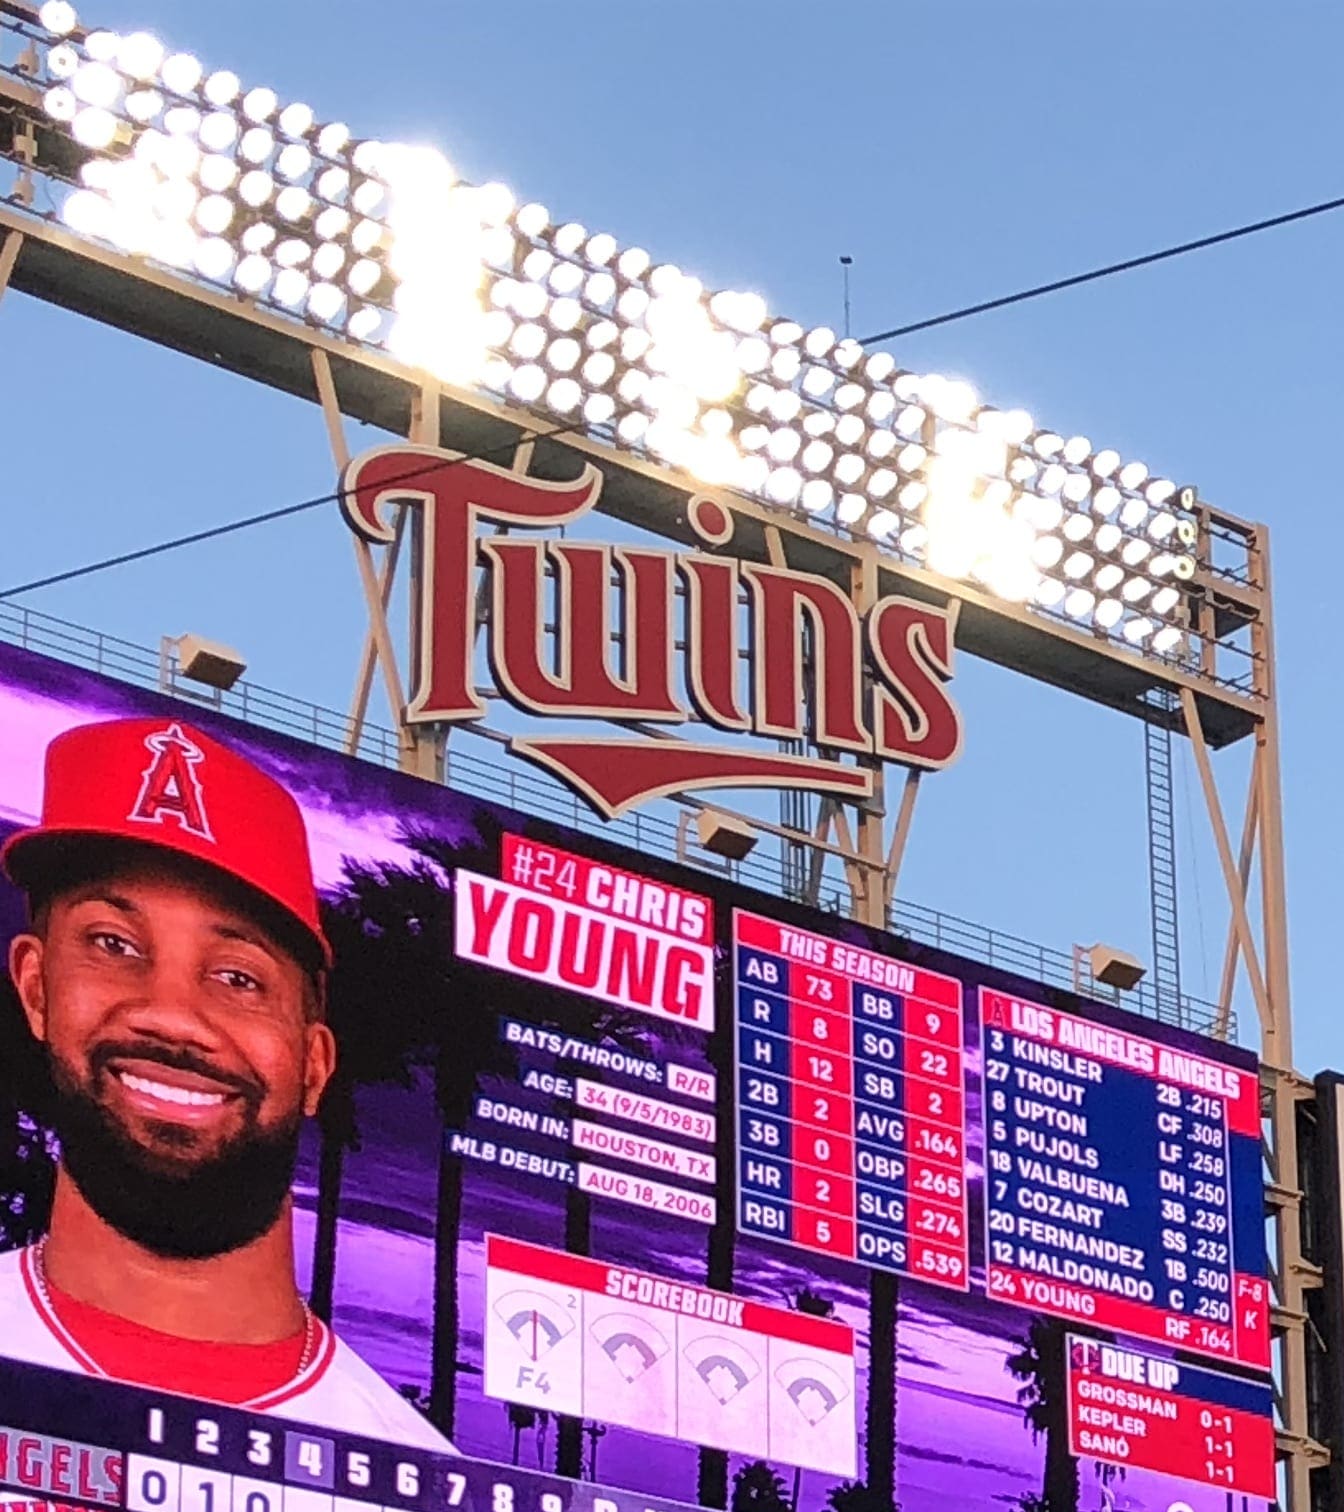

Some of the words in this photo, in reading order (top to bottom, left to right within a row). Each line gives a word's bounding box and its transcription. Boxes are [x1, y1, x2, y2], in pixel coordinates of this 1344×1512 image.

[341, 445, 964, 770] Twins
[512, 844, 577, 898] #24
[585, 866, 707, 939] CHRIS
[469, 881, 705, 1021] YOUNG
[745, 958, 778, 984] AB
[806, 975, 833, 1001] 73
[780, 929, 826, 964] THIS
[832, 946, 915, 993] SEASON
[862, 993, 893, 1020] BB
[506, 1022, 663, 1083] BATS/THROWS:
[675, 1071, 710, 1095] R/R
[863, 1033, 895, 1059] SO
[921, 1051, 948, 1076] 22
[1011, 1002, 1053, 1040] LOS
[1058, 1017, 1154, 1073] ANGELES
[1159, 1050, 1240, 1099] ANGELS
[1013, 1037, 1103, 1083] KINSLER
[1156, 1084, 1182, 1107] 2B
[524, 1070, 574, 1099] AGE:
[584, 1087, 606, 1108] 34
[613, 1092, 713, 1138] (9/5/1983)
[864, 1073, 895, 1099] SB
[1014, 1067, 1086, 1106] TROUT
[1157, 1113, 1182, 1135] CF
[477, 1099, 538, 1131] BORN
[542, 1115, 569, 1140] IN:
[580, 1128, 680, 1173] HOUSTON,
[687, 1157, 710, 1176] TX
[858, 1111, 905, 1141] AVG
[915, 1130, 958, 1158] .164
[1015, 1096, 1087, 1137] UPTON
[1159, 1142, 1182, 1165] LF
[1016, 1127, 1099, 1170] PUJOLS
[1159, 1169, 1185, 1196] DH
[452, 1135, 497, 1162] MLB
[500, 1148, 575, 1184] DEBUT:
[587, 1172, 628, 1195] AUG
[634, 1184, 658, 1207] 18,
[665, 1193, 712, 1218] 2006
[748, 1161, 781, 1189] HR
[858, 1152, 905, 1180] OBP
[913, 1169, 961, 1198] .265
[1017, 1156, 1130, 1208] VALBUENA
[1161, 1198, 1186, 1224] 3B
[745, 1202, 785, 1232] RBI
[860, 1193, 905, 1221] SLG
[916, 1210, 961, 1238] .274
[1017, 1187, 1103, 1228] COZART
[1162, 1228, 1187, 1253] SS
[859, 1233, 906, 1263] OPS
[915, 1251, 962, 1277] .539
[1019, 1217, 1145, 1270] FERNANDEZ
[1165, 1258, 1187, 1283] 1B
[1019, 1246, 1154, 1302] MALDONADO
[605, 1270, 746, 1328] SCOREBOOK
[1020, 1277, 1096, 1316] YOUNG
[1165, 1317, 1190, 1341] RF
[1077, 1380, 1177, 1420] GROSSMAN
[1101, 1347, 1145, 1386] DUE
[1147, 1360, 1180, 1391] UP
[1078, 1404, 1147, 1437] KEPLER
